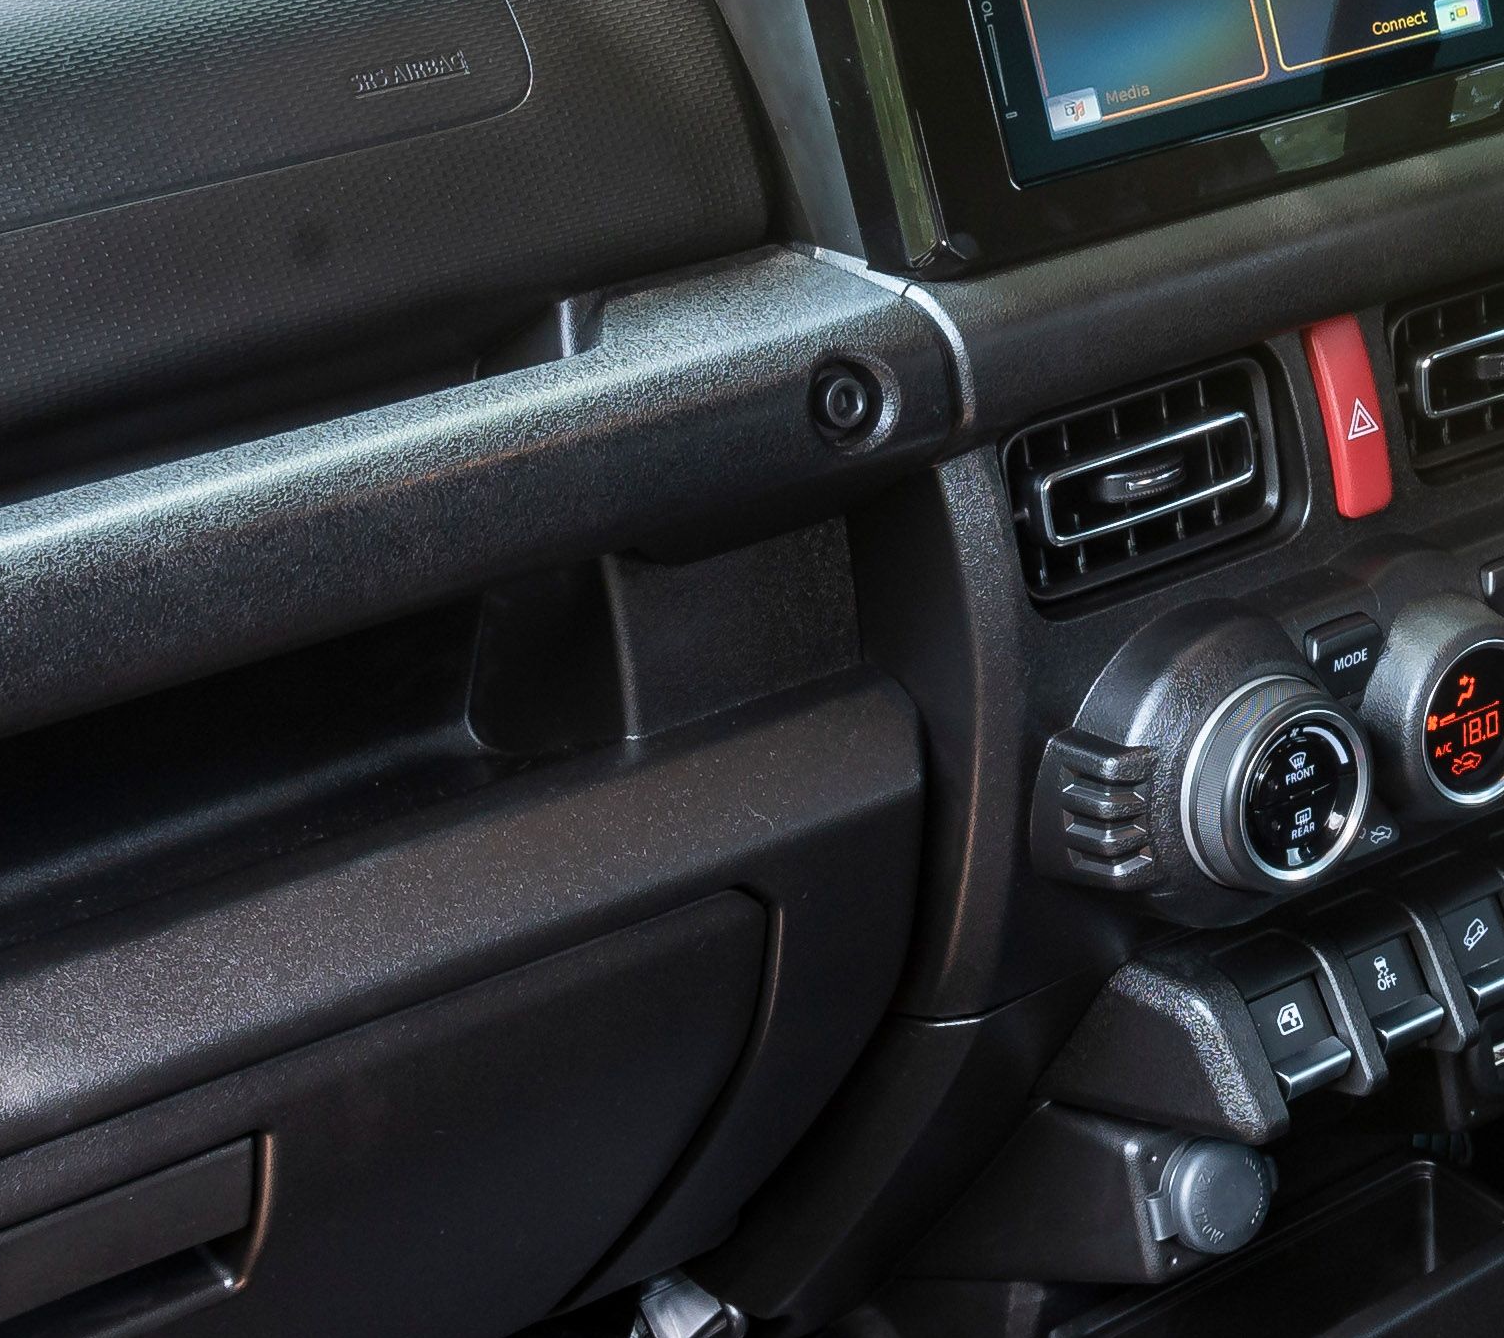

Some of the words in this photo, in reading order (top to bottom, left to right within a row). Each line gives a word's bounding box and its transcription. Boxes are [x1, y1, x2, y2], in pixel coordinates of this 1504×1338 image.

[1372, 9, 1428, 36] Connect
[1105, 84, 1151, 105] Media
[1333, 648, 1368, 672] MODE
[1461, 710, 1500, 747] 18.0
[1435, 742, 1452, 758] A/C
[1285, 764, 1315, 786] FRONT
[1291, 822, 1315, 840] REAR
[1377, 972, 1398, 991] OFF
